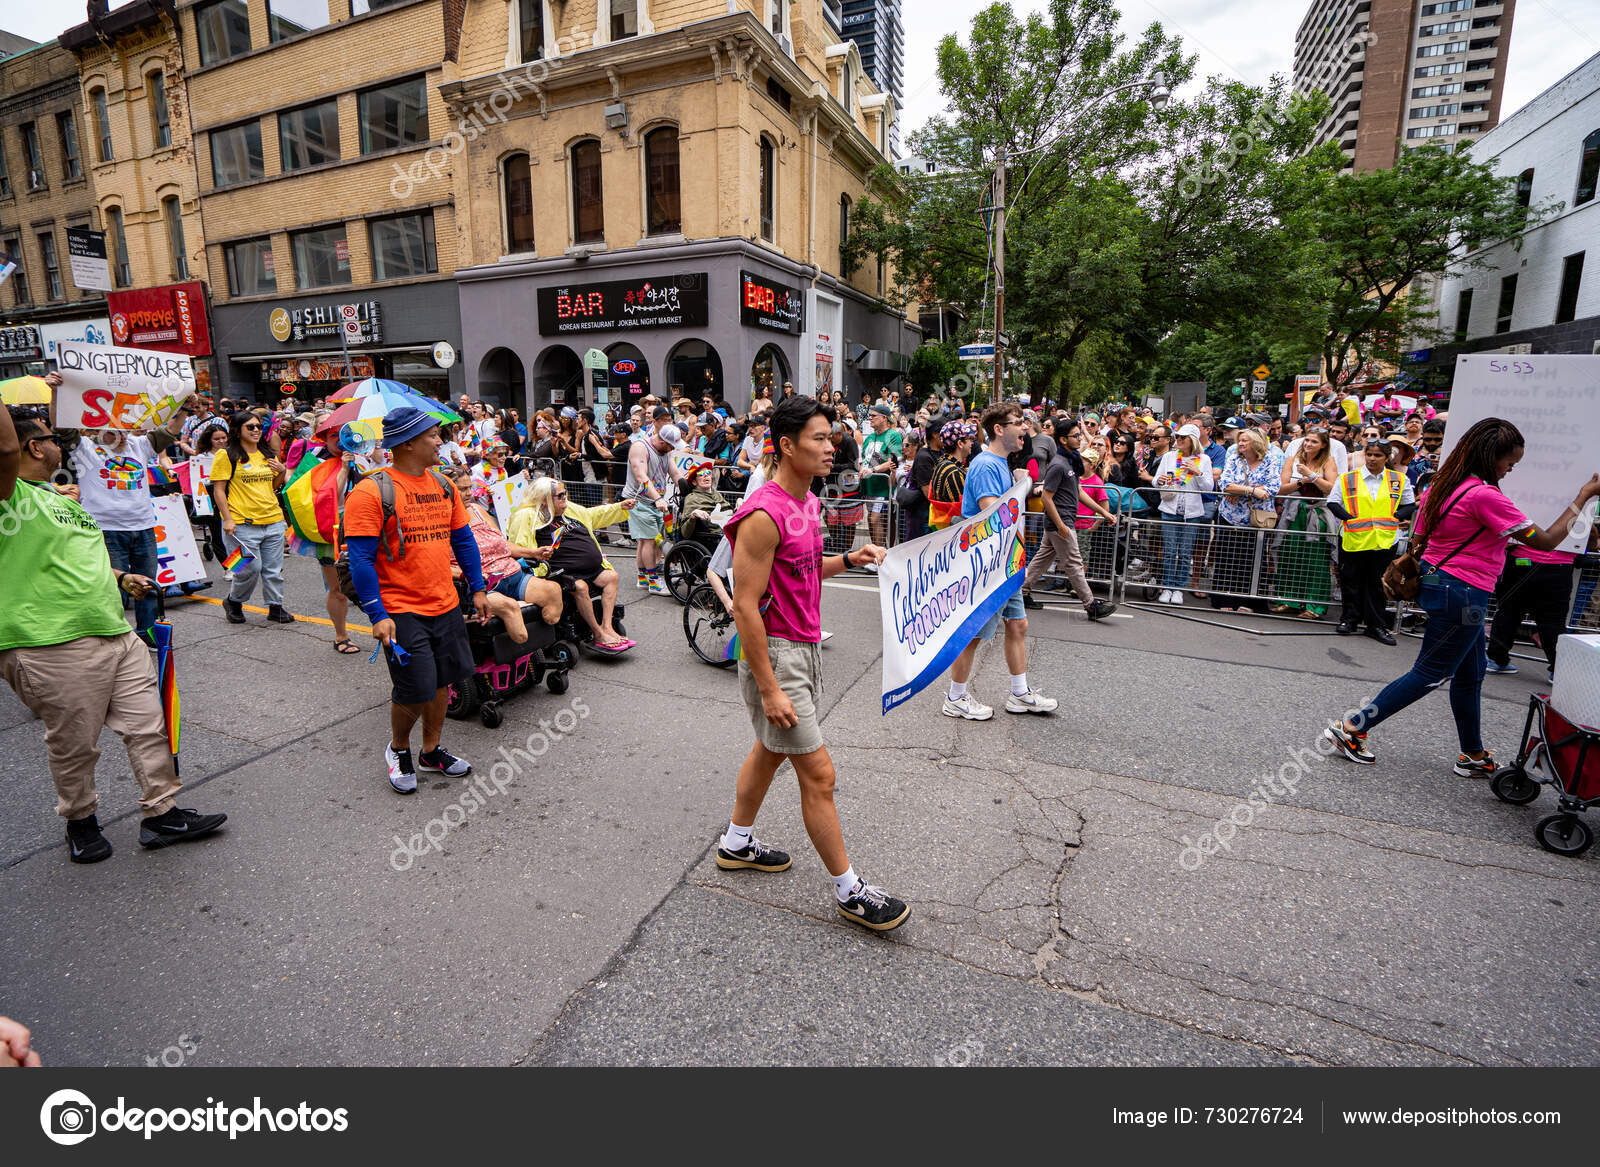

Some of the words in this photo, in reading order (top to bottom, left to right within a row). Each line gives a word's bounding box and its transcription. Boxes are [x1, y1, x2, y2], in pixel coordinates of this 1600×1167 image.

[558, 292, 604, 318] BAR
[745, 282, 775, 314] BAR
[559, 323, 580, 331] KOREAN
[581, 320, 614, 329] RESTAURANT
[618, 319, 639, 327] JOKBAL
[641, 317, 657, 325] NIGHT
[658, 316, 682, 324] MARKET
[614, 362, 635, 373] OPEN
[81, 388, 189, 430] SEXY
[960, 498, 1019, 552] SENIORS
[904, 575, 970, 656] TORONTO
